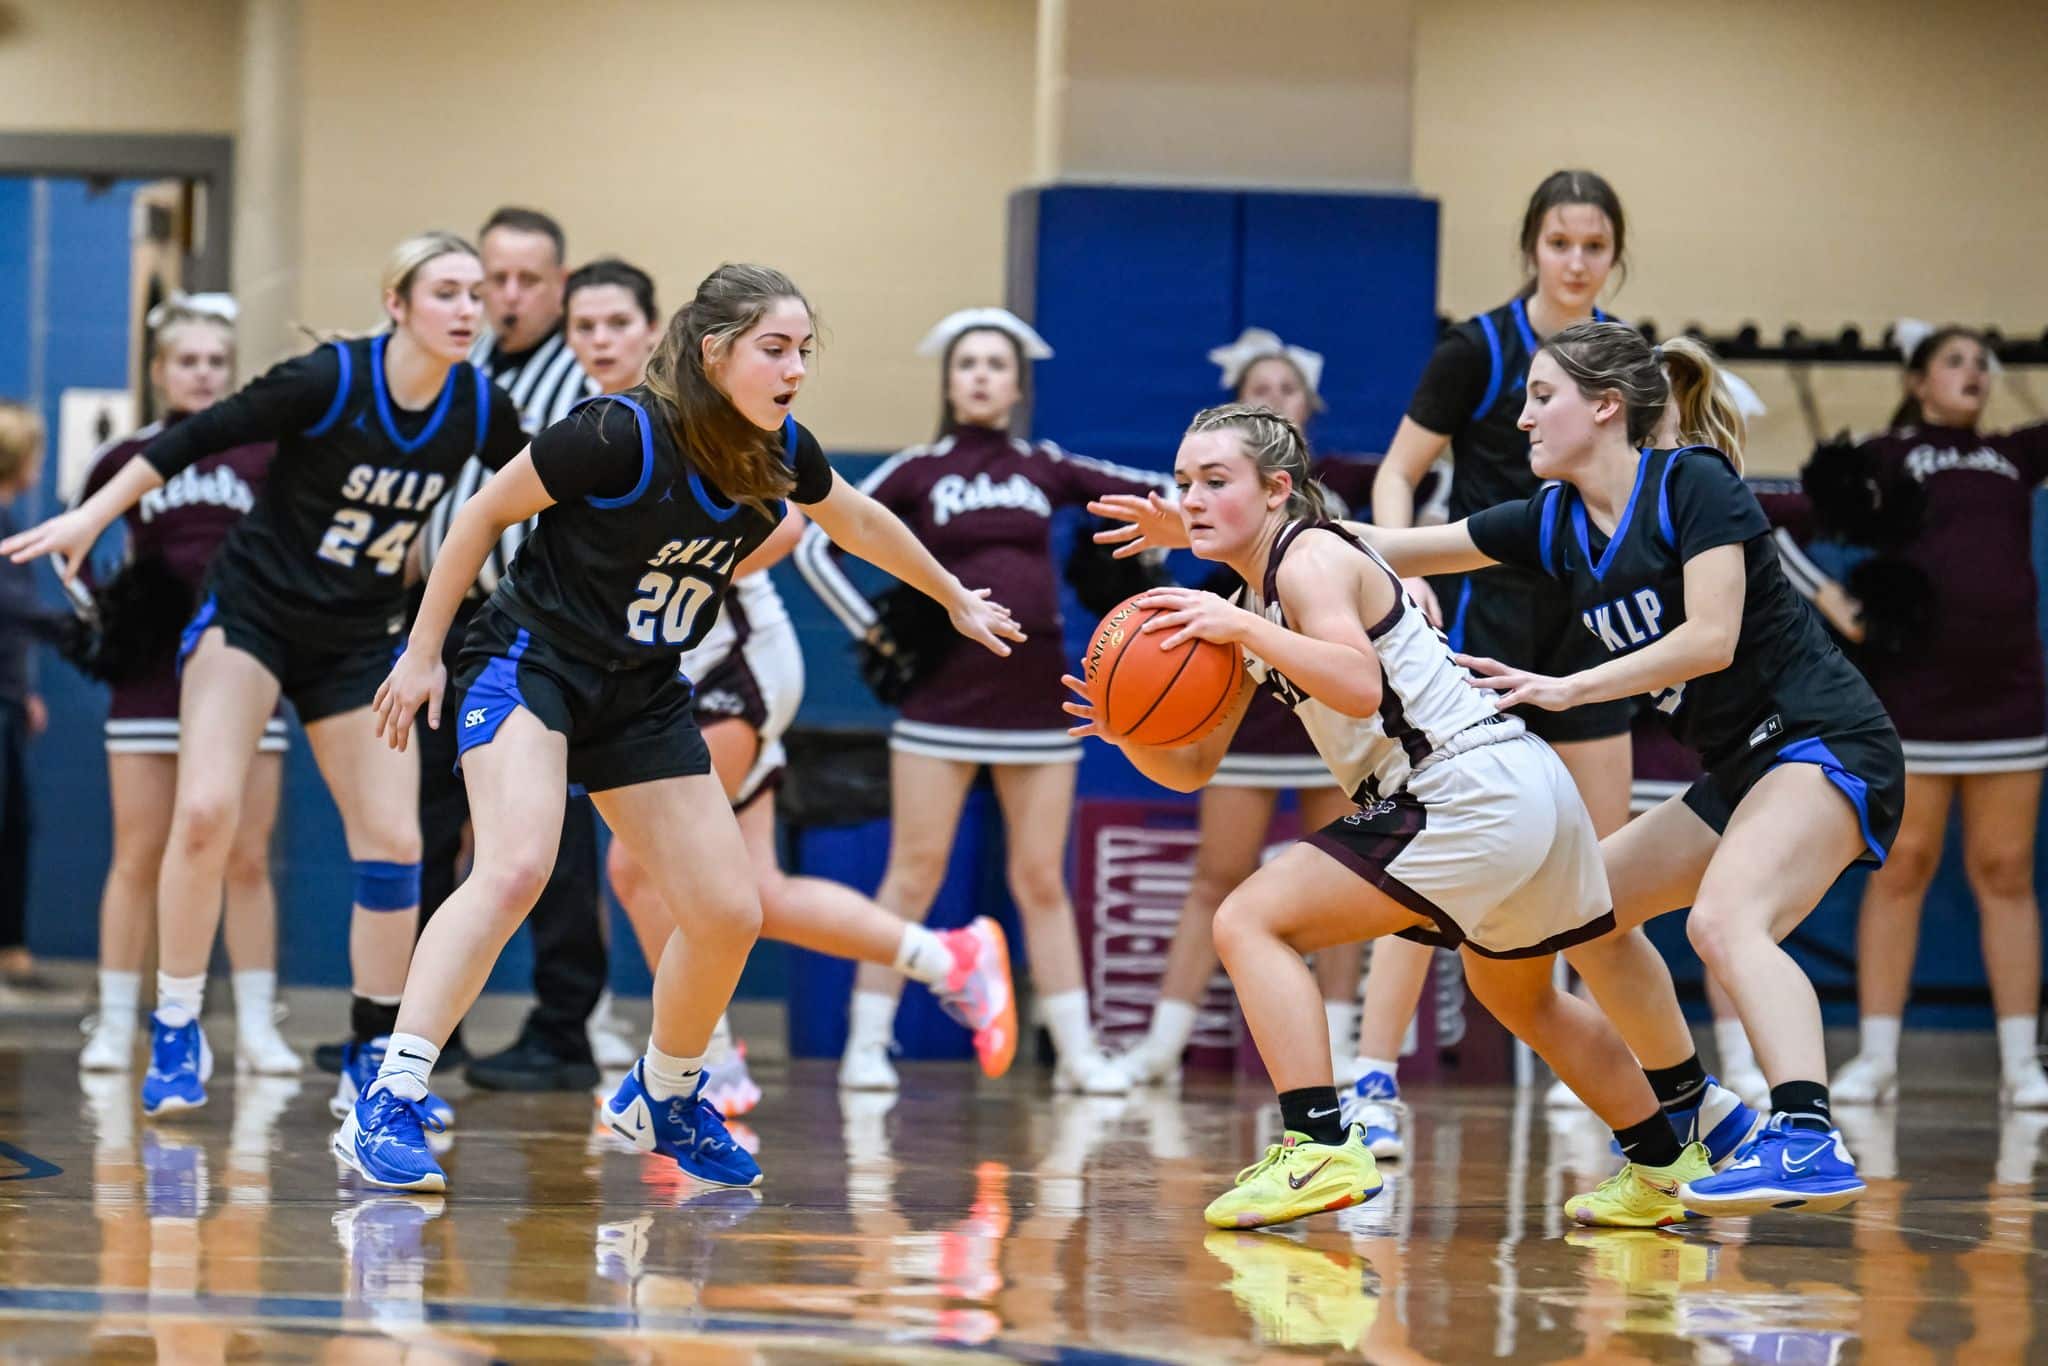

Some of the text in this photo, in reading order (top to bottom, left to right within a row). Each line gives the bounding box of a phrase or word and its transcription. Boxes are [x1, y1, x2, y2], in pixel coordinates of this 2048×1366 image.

[341, 463, 445, 512] SKLP
[316, 507, 418, 575] 24
[624, 570, 715, 645] 20
[1087, 597, 1142, 684] PALDING
[465, 707, 489, 729] SK
